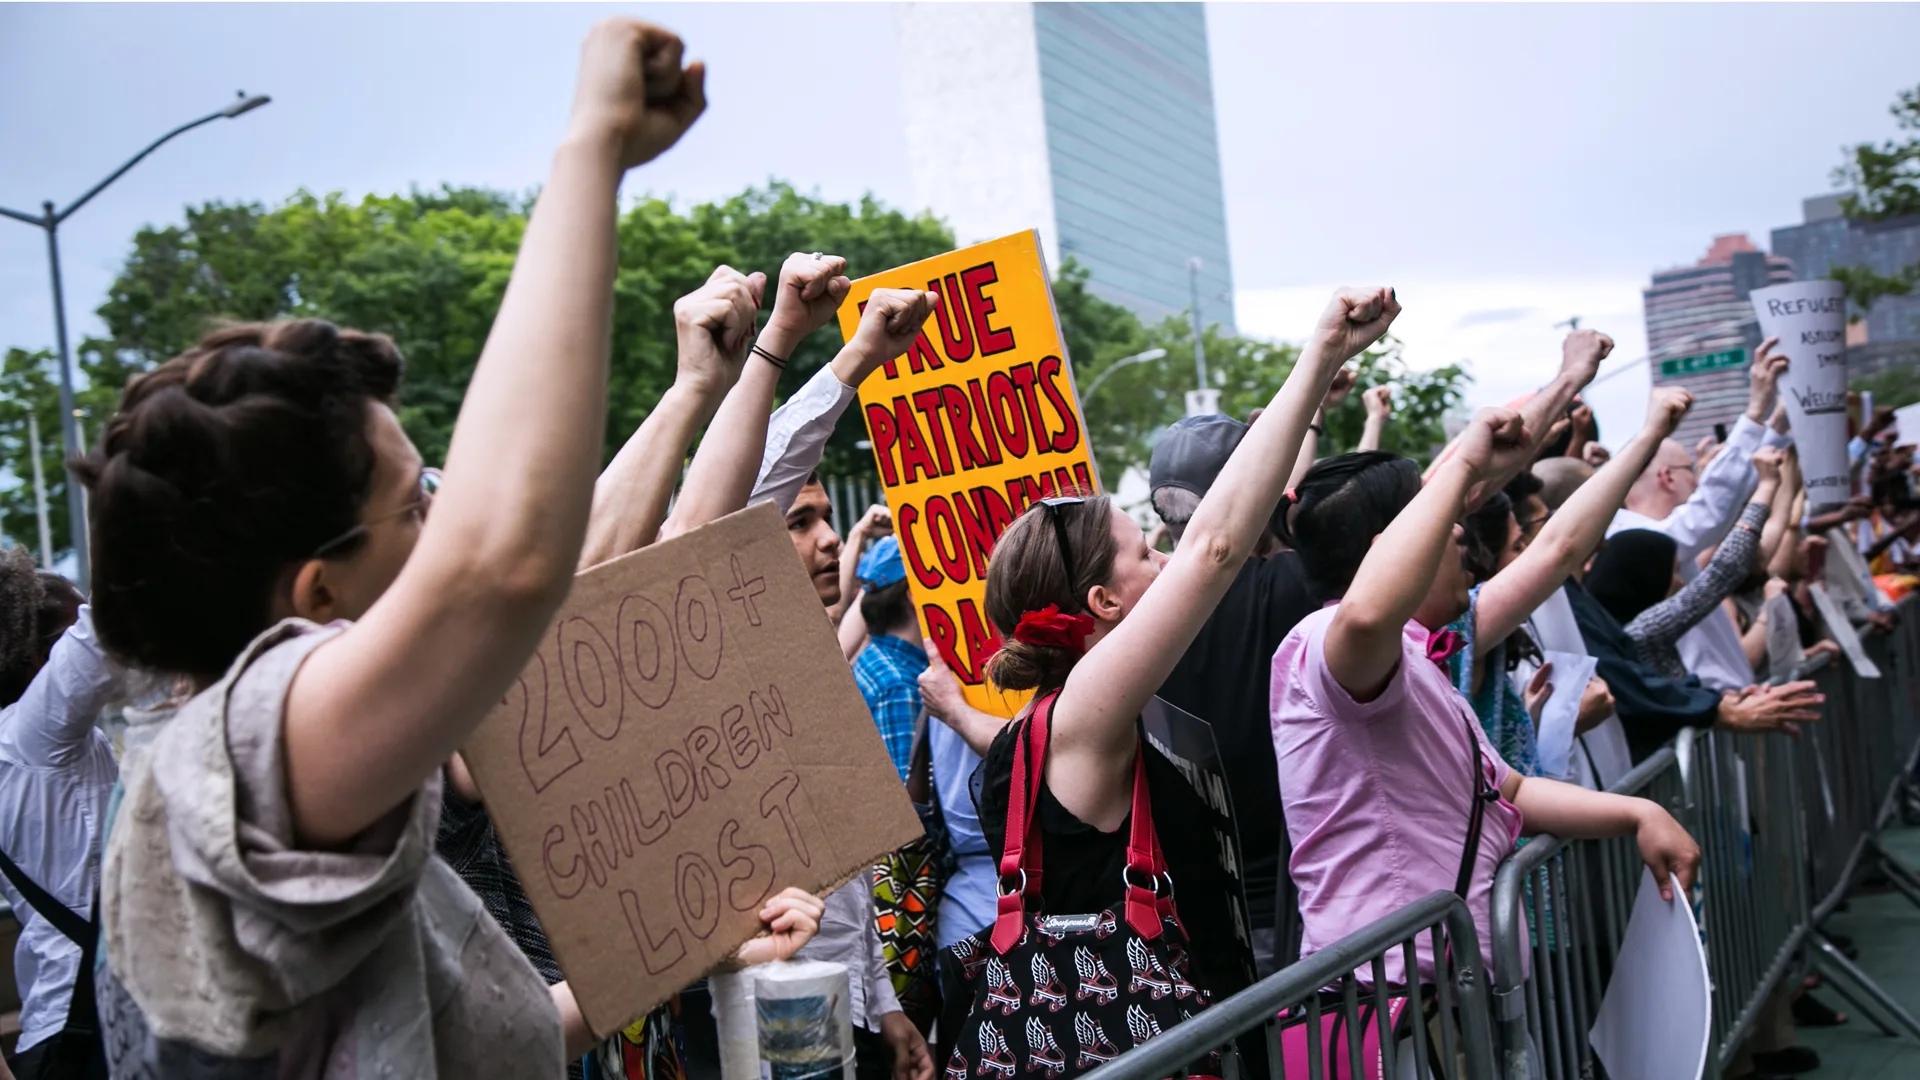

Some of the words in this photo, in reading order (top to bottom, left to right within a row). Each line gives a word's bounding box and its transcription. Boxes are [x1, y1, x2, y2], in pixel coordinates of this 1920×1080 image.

[857, 261, 1016, 380] UE
[865, 355, 1079, 487] PATRIOTS
[500, 553, 765, 793] 2000+
[543, 684, 793, 900] CHILDREN
[619, 770, 811, 975] LOST
